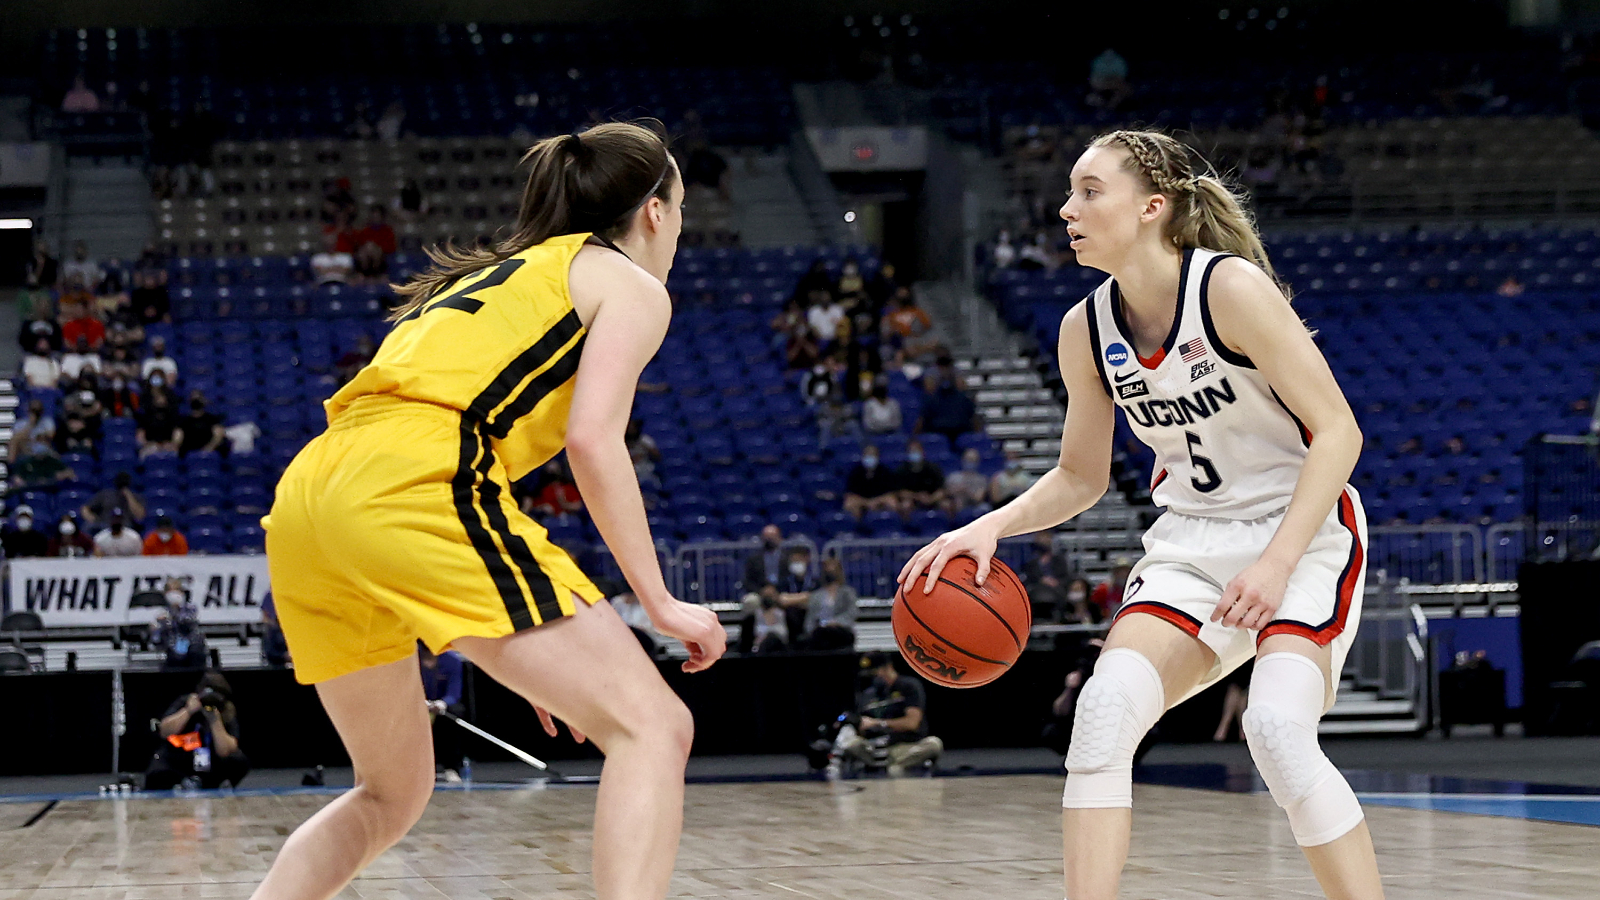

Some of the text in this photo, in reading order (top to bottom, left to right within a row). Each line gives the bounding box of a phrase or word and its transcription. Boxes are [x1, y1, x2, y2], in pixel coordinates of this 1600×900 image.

[1108, 352, 1127, 362] NCAA
[1191, 360, 1208, 373] BIG
[1190, 363, 1216, 380] EAST
[1122, 383, 1144, 395] BLM
[1123, 375, 1237, 427] UCONN
[1185, 429, 1223, 493] 5
[26, 574, 258, 611] WHAT IT ALL
[904, 634, 967, 681] NCAA
